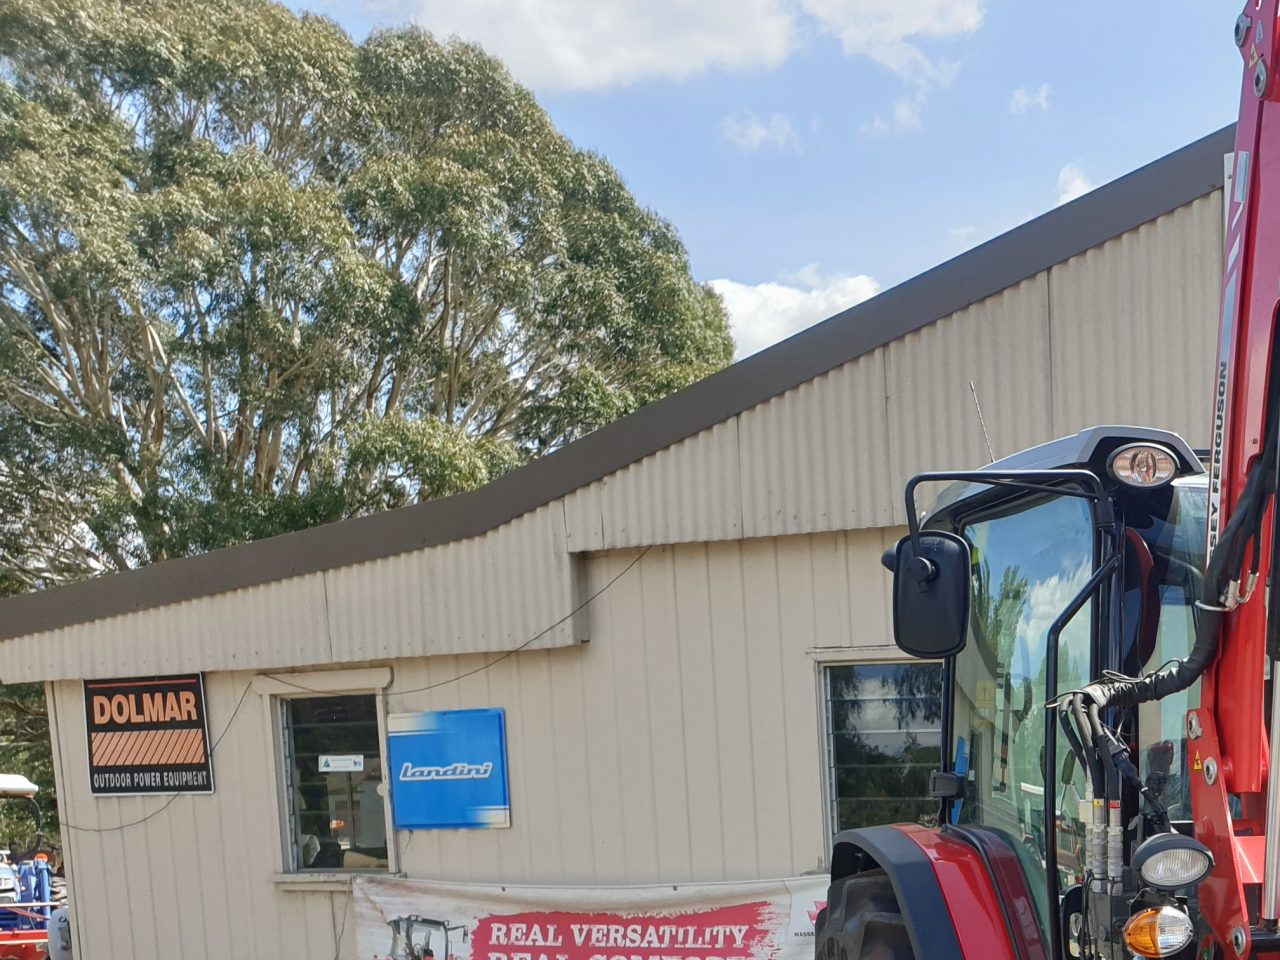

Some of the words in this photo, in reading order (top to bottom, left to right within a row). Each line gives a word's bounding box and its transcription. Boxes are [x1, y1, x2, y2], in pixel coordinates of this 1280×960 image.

[1212, 361, 1227, 494] FERGUSON
[93, 691, 198, 724] DOLMAR
[93, 773, 132, 788] OUTDOOR
[134, 772, 161, 786] POWER
[164, 771, 207, 786] EQUIPMENT
[489, 923, 562, 946] REAL
[570, 924, 749, 948] VERSATILITY
